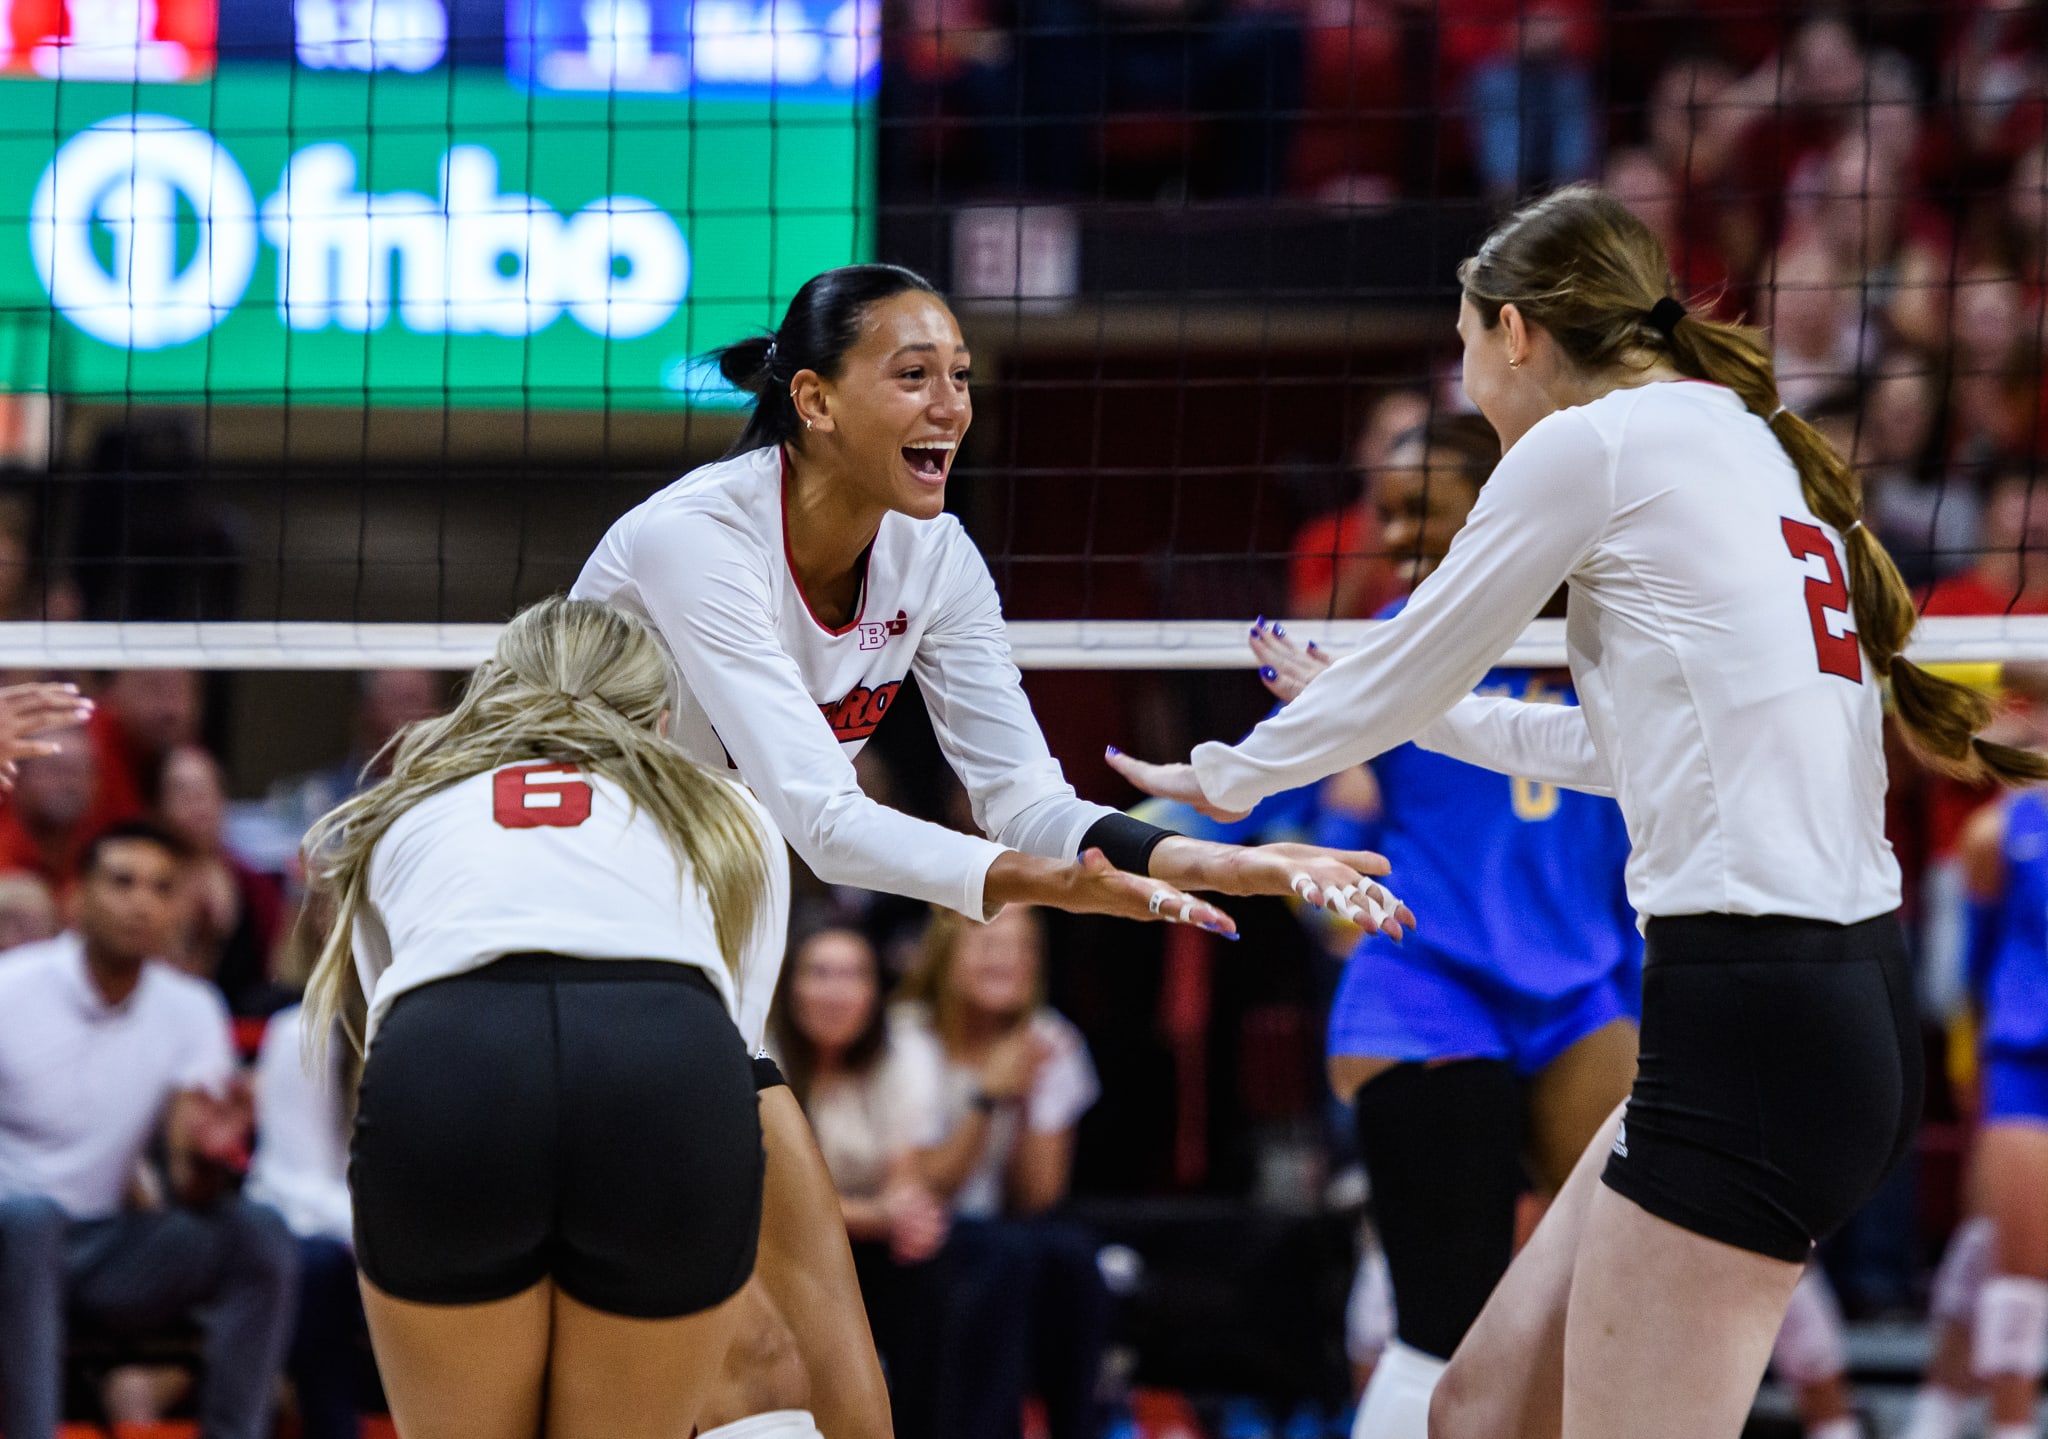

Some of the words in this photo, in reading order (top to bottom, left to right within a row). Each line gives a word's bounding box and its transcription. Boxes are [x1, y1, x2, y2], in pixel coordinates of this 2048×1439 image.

[262, 142, 689, 338] fnbo
[1780, 515, 1863, 685] 2
[493, 762, 593, 828] 6
